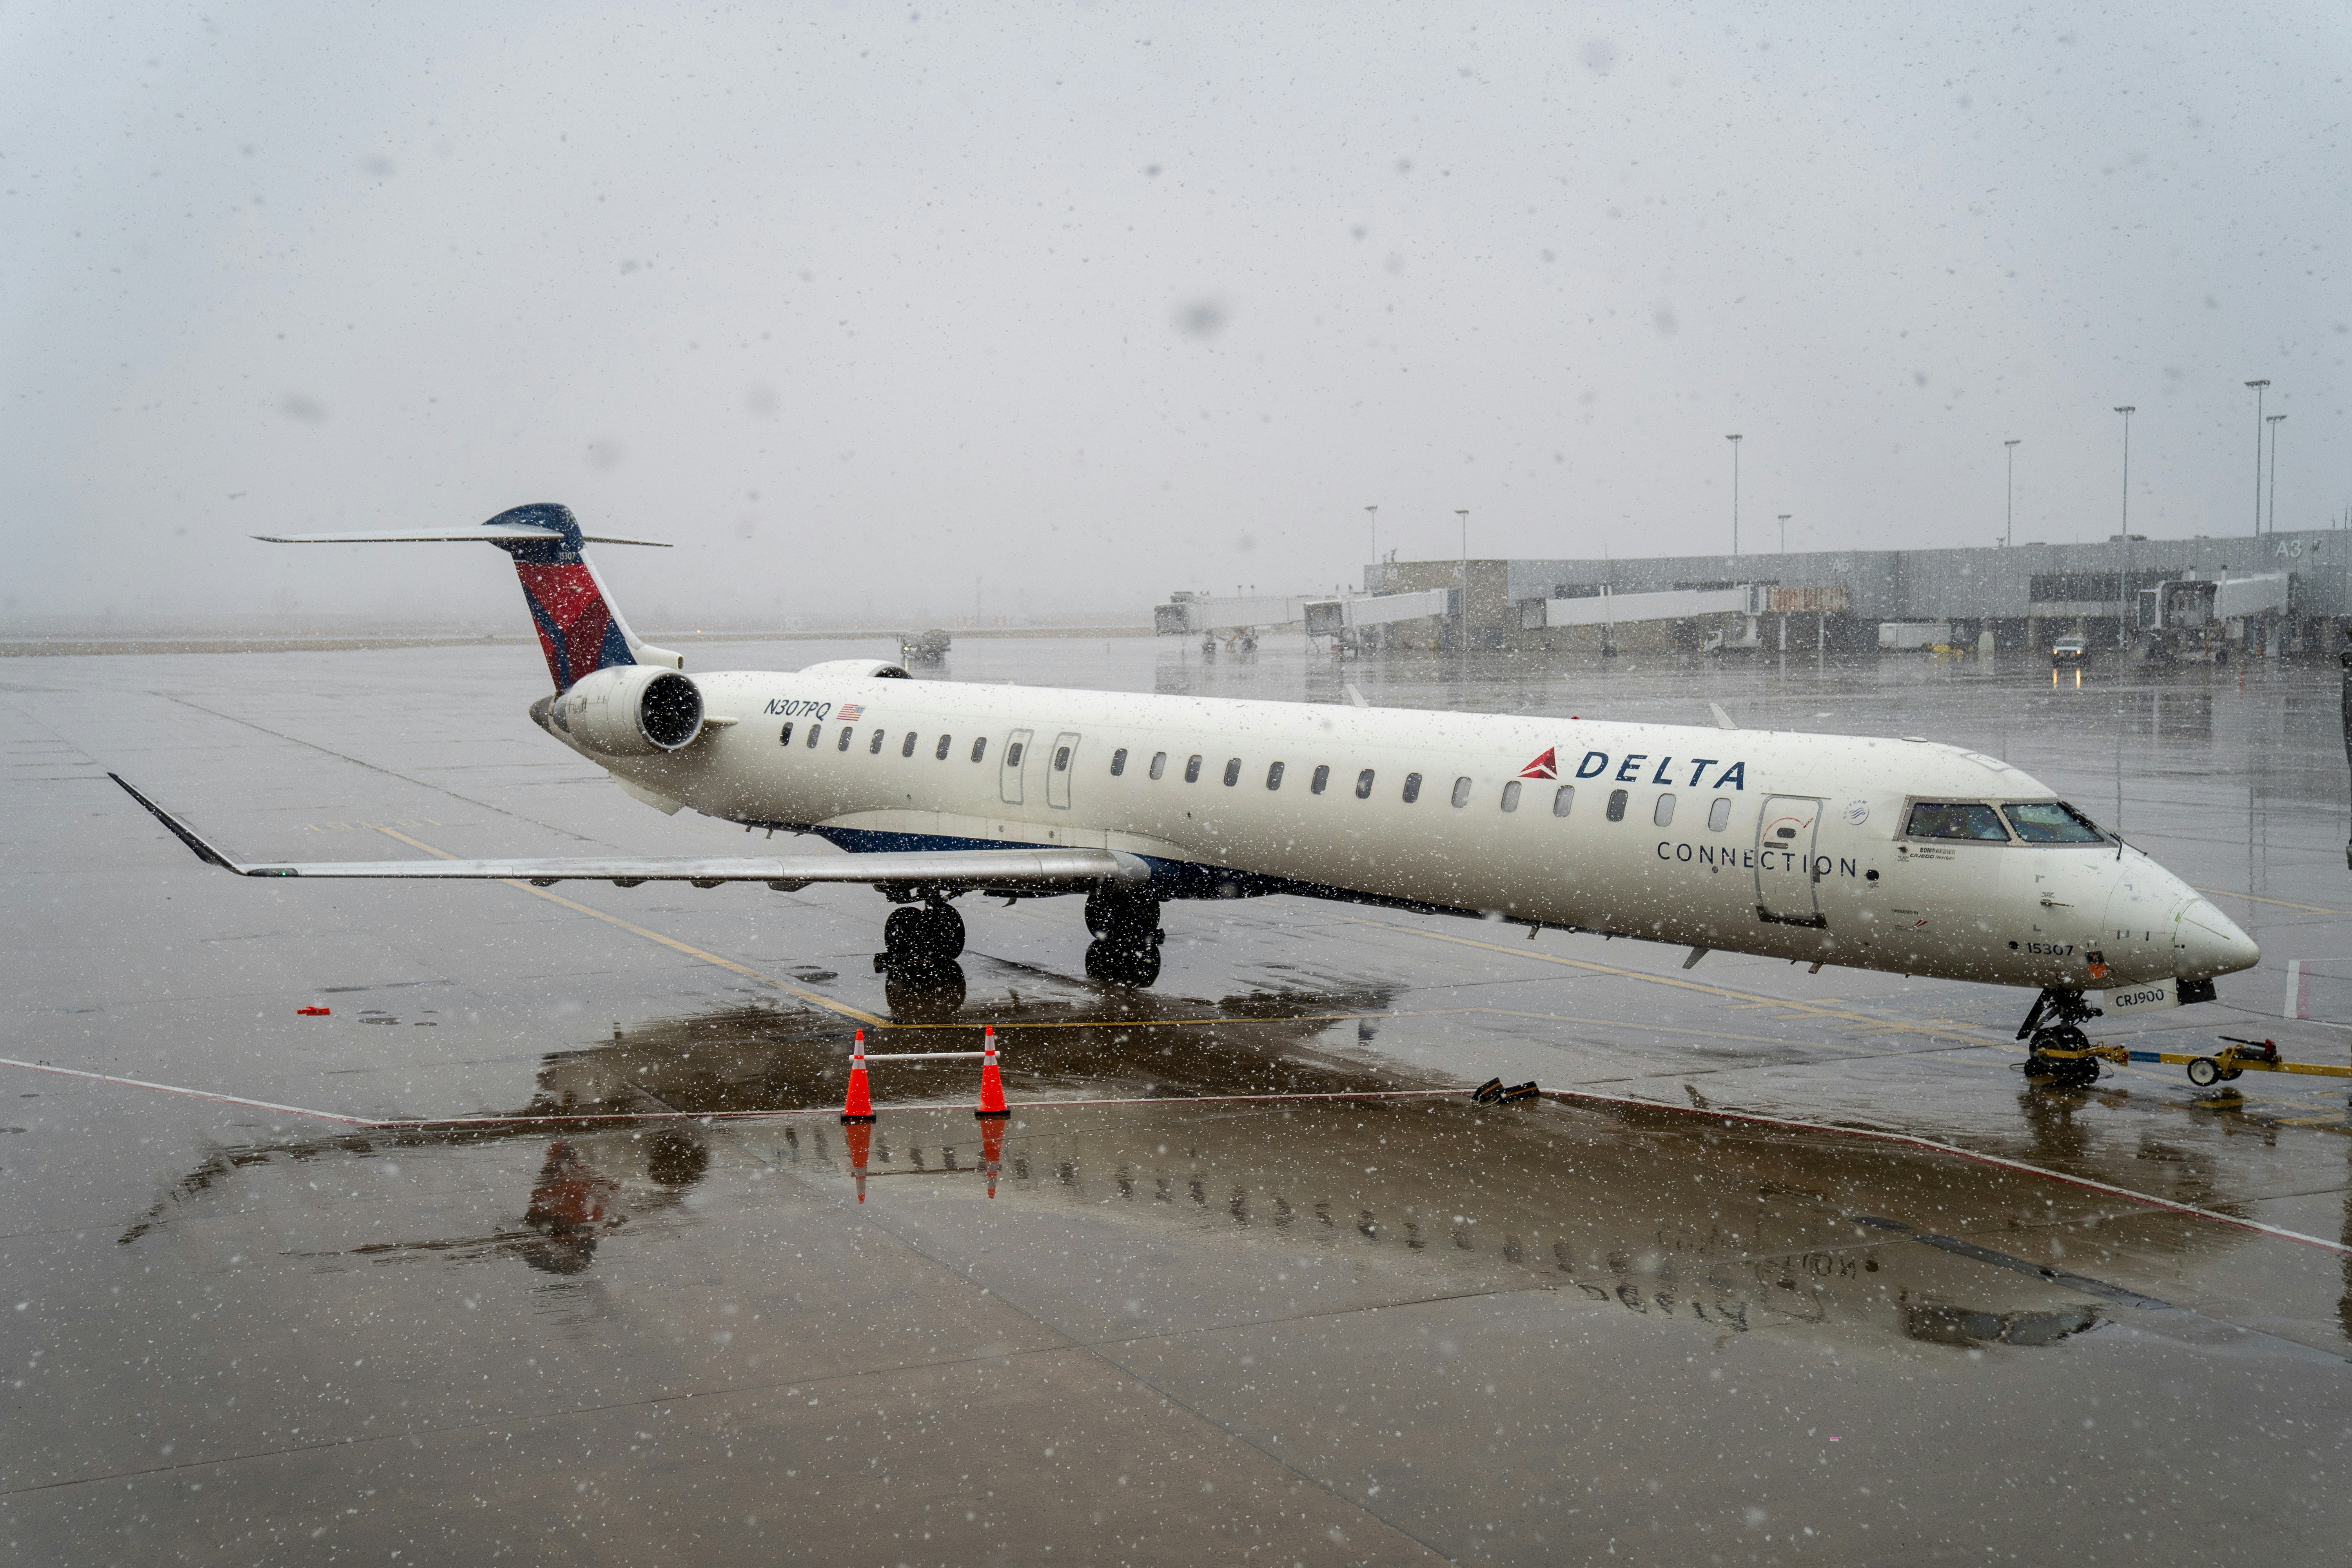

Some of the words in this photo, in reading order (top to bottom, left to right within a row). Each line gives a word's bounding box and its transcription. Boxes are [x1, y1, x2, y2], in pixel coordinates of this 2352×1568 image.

[559, 551, 575, 560] 15307
[2275, 540, 2301, 558] A3
[1832, 558, 1849, 572] A5
[764, 699, 831, 721] N307PQ
[1575, 751, 1745, 790] DELTA
[1657, 842, 1856, 877] CONNECTION
[2025, 943, 2073, 956] 15307
[2116, 989, 2164, 1007] CRJ900
